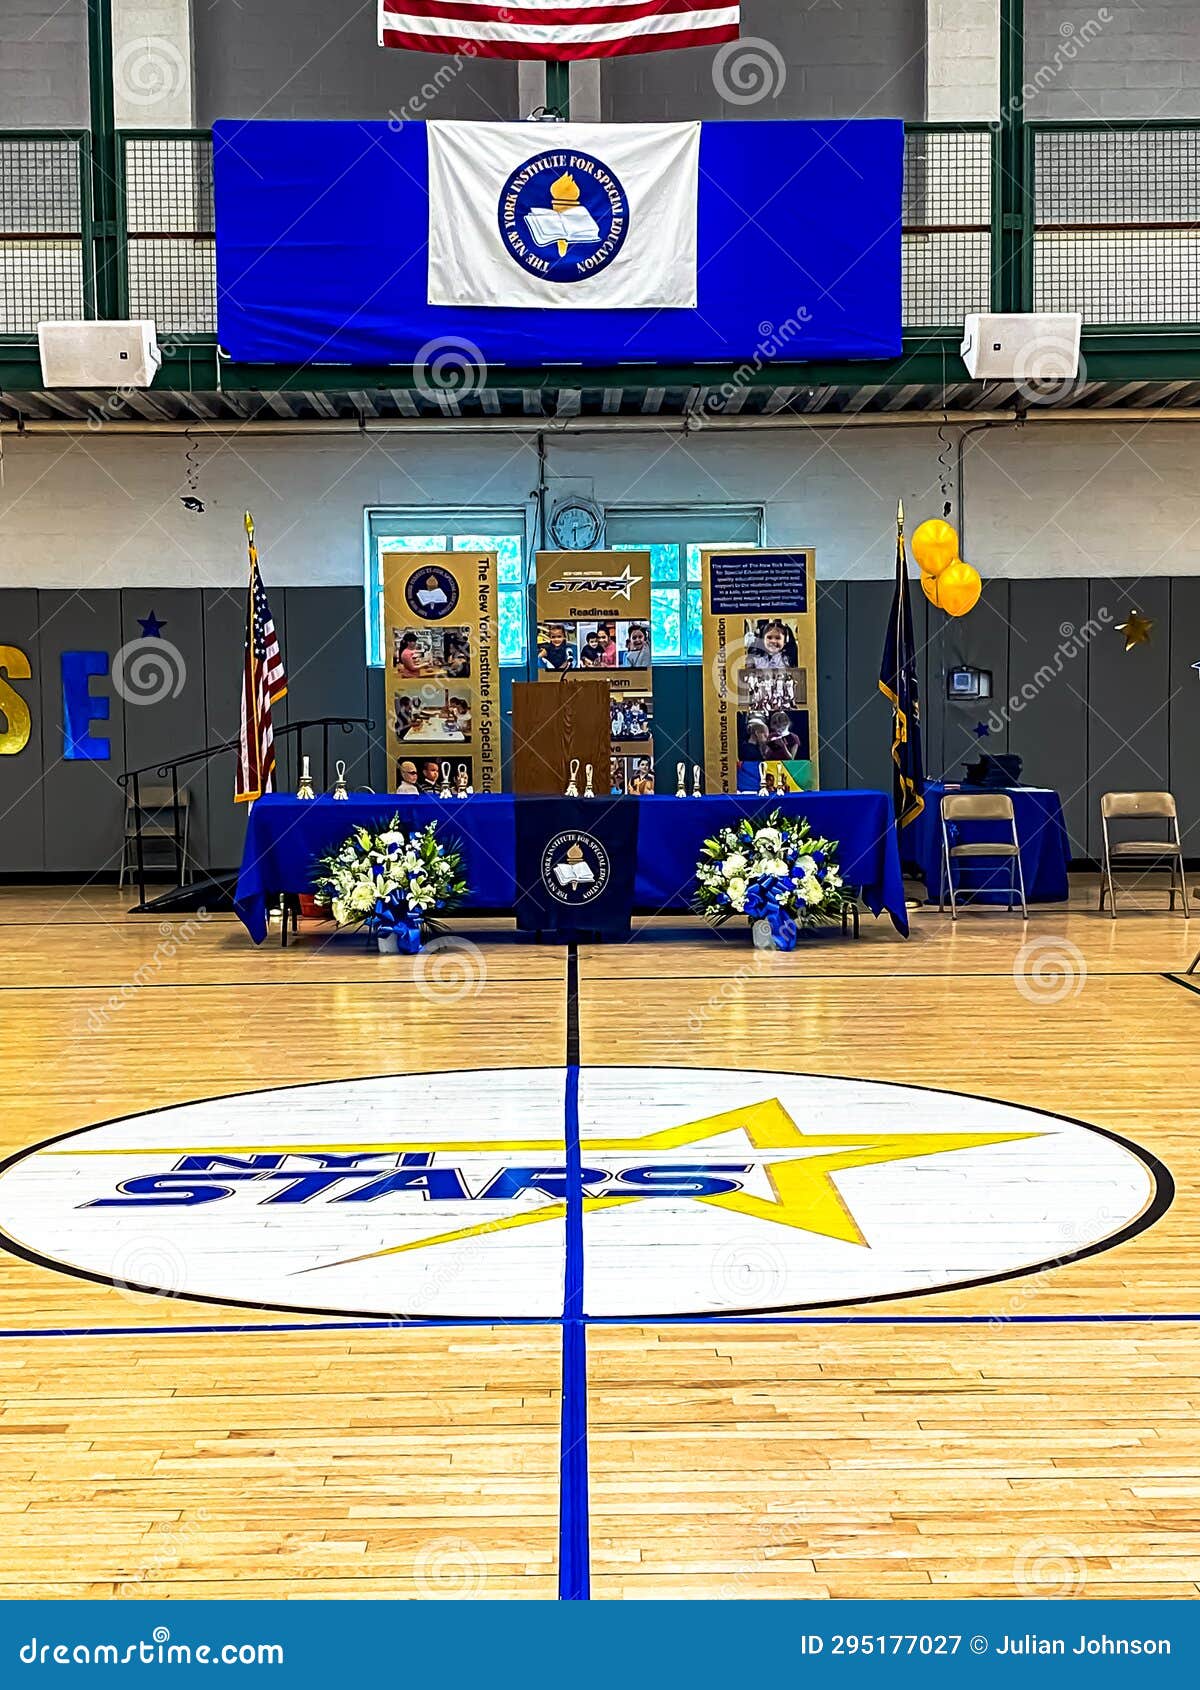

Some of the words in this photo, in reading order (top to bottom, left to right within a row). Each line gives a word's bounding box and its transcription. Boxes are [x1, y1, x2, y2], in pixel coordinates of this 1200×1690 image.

[510, 155, 567, 193] INSTITUTE
[570, 156, 595, 174] FOR
[594, 169, 624, 215] SPECIAL
[504, 193, 518, 229] YORK
[507, 231, 528, 257] NEW
[577, 217, 624, 273] EDUCATION
[525, 253, 550, 273] THE
[478, 557, 490, 581] The
[479, 585, 489, 612] New
[547, 580, 628, 593] STARS
[569, 608, 620, 617] Readiness
[479, 615, 491, 643] York
[717, 618, 726, 663] Education
[480, 646, 491, 696] Institute
[718, 666, 728, 698] Special
[480, 700, 492, 718] for
[718, 700, 727, 713] for
[479, 720, 492, 762] Special
[719, 715, 728, 754] Institute
[720, 756, 728, 778] York
[578, 835, 590, 845] FOR
[170, 1151, 436, 1172] NYI
[73, 1163, 756, 1209] STARS
